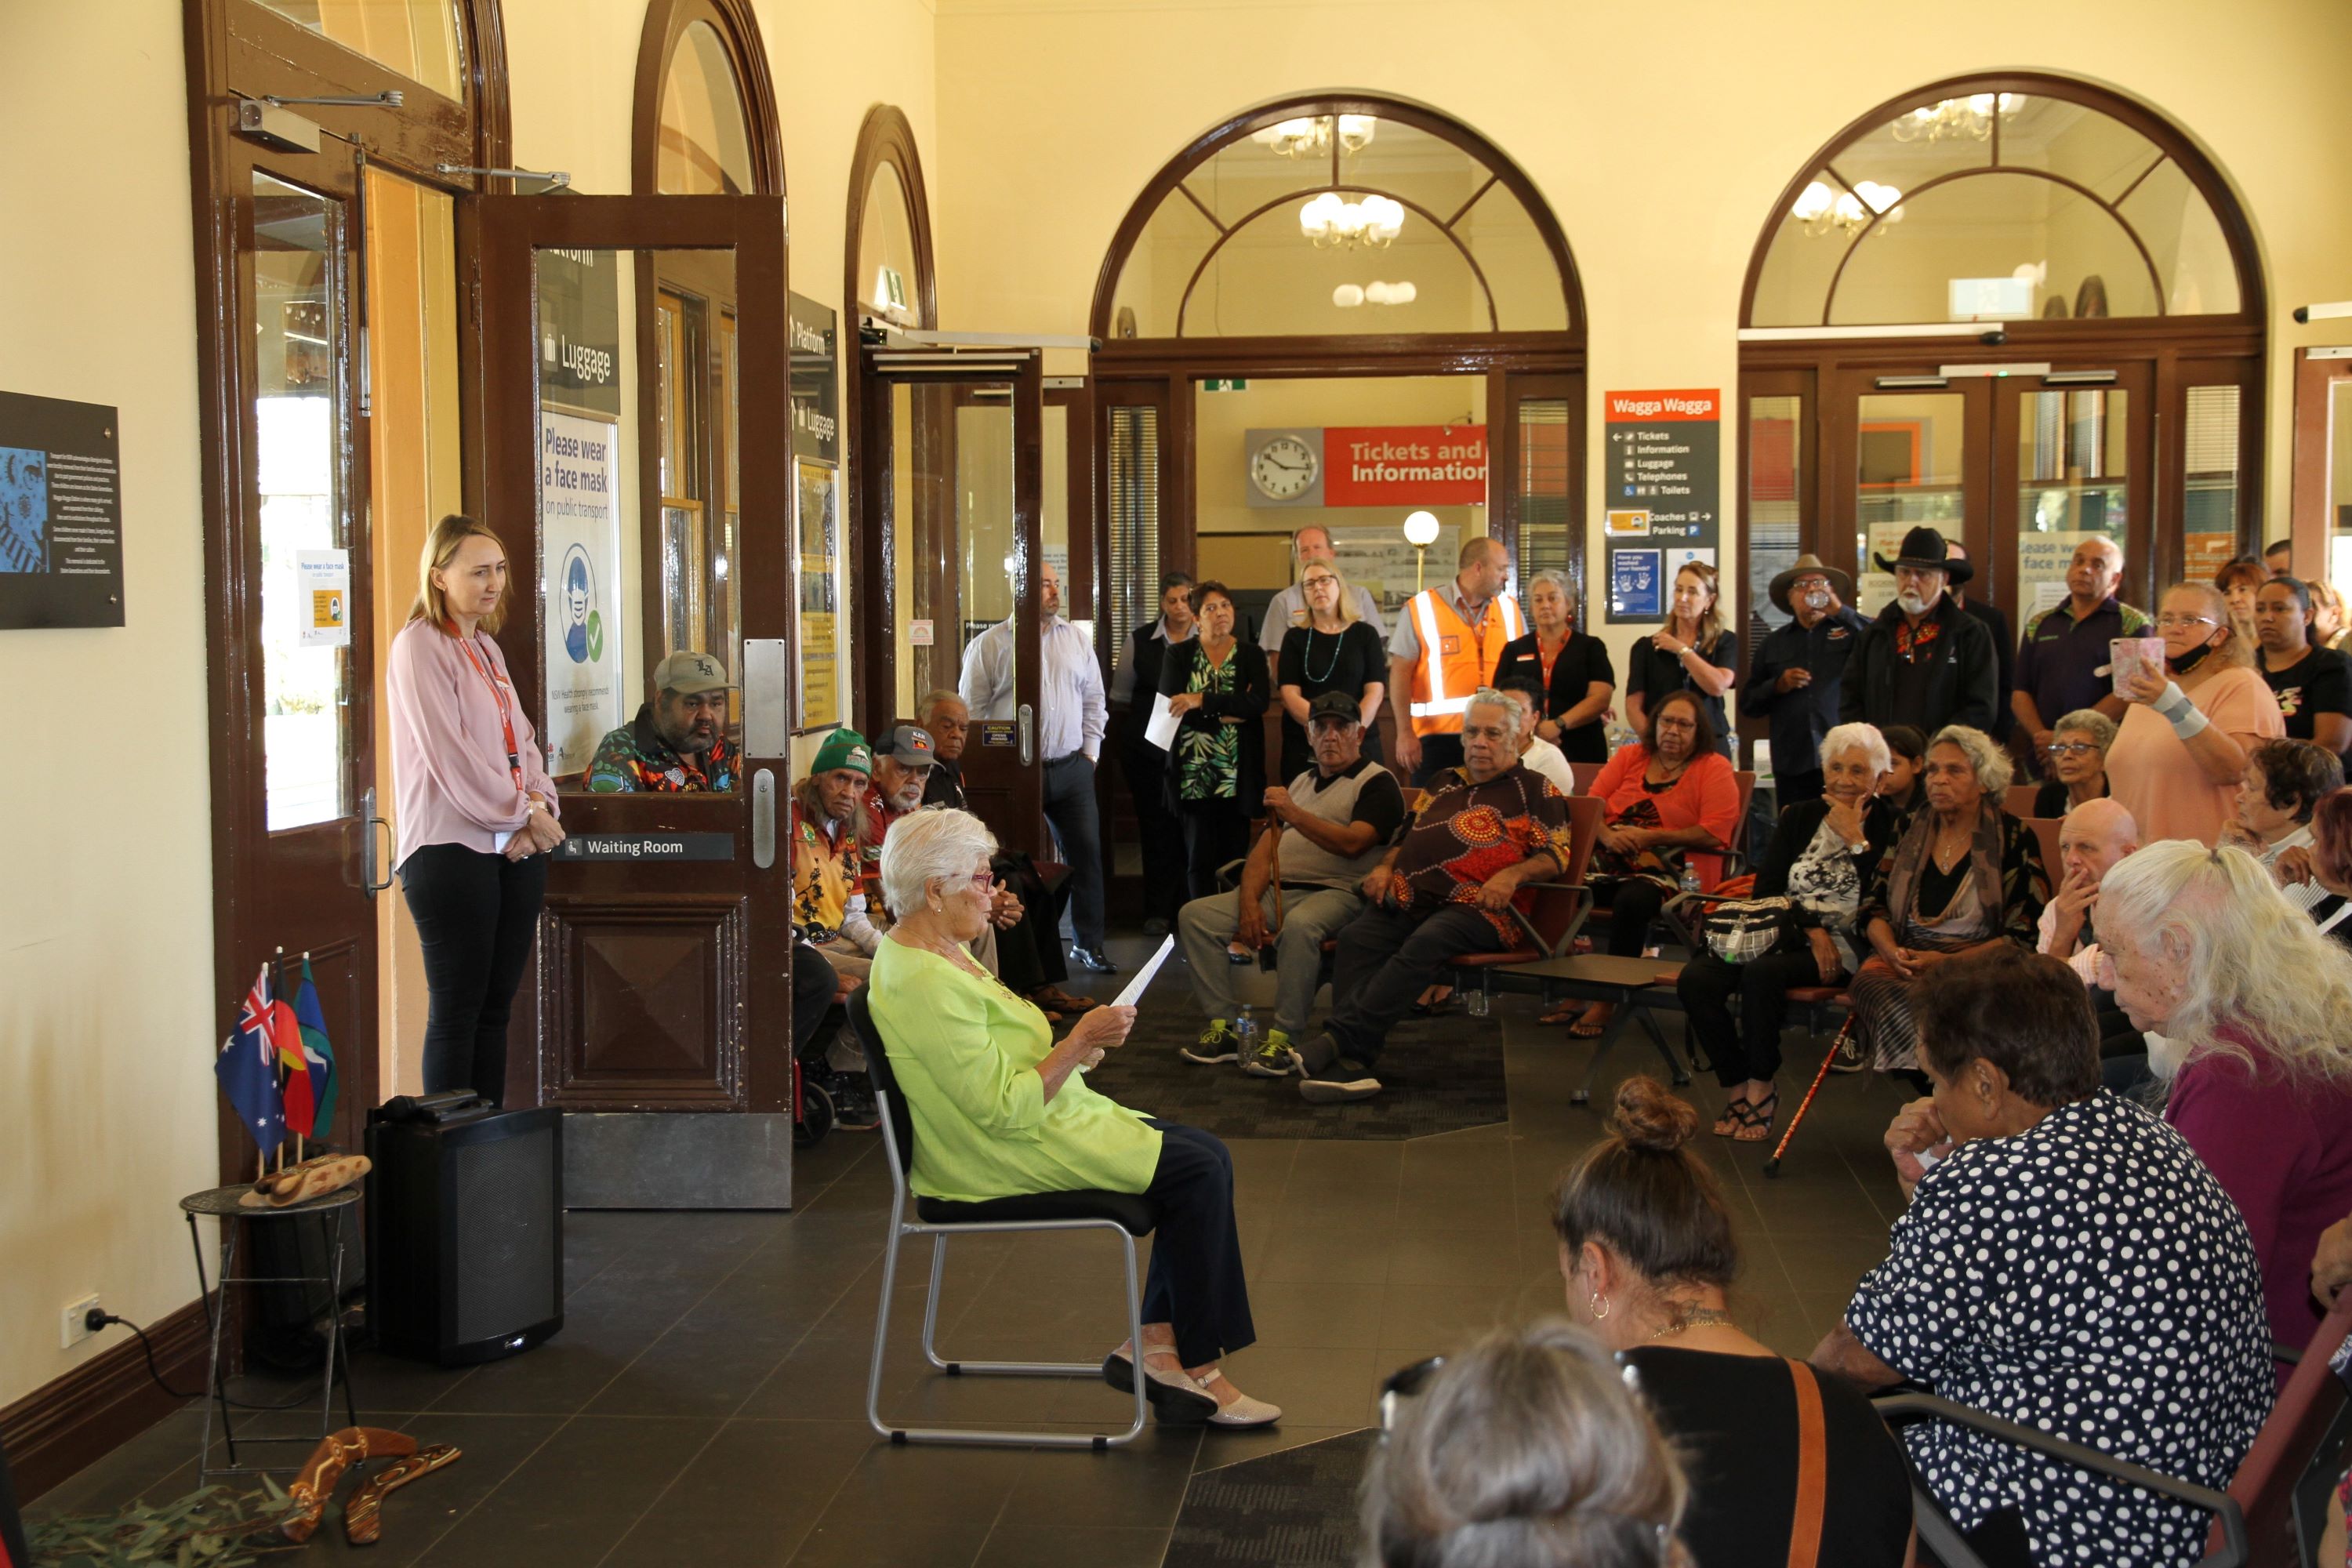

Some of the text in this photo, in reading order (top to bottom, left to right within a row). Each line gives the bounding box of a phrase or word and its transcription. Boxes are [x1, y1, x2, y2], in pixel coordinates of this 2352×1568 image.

[797, 321, 826, 356] Platform
[561, 334, 611, 384] Luggage
[1613, 398, 1712, 416] Wagga Wagga
[807, 405, 835, 443] Luggage
[545, 426, 607, 463] Please wear
[1637, 432, 1670, 441] Tickets
[1350, 440, 1482, 461] Tickets and
[1637, 445, 1690, 455] Information
[1637, 459, 1675, 470] Luggage
[545, 460, 608, 493] a face mask
[1637, 472, 1688, 482] Telephones
[1661, 485, 1691, 495] Toilets
[546, 496, 608, 523] on public transport
[1649, 512, 1686, 522] Coaches
[1653, 526, 1686, 536] Parking
[587, 840, 684, 857] Waiting Room
